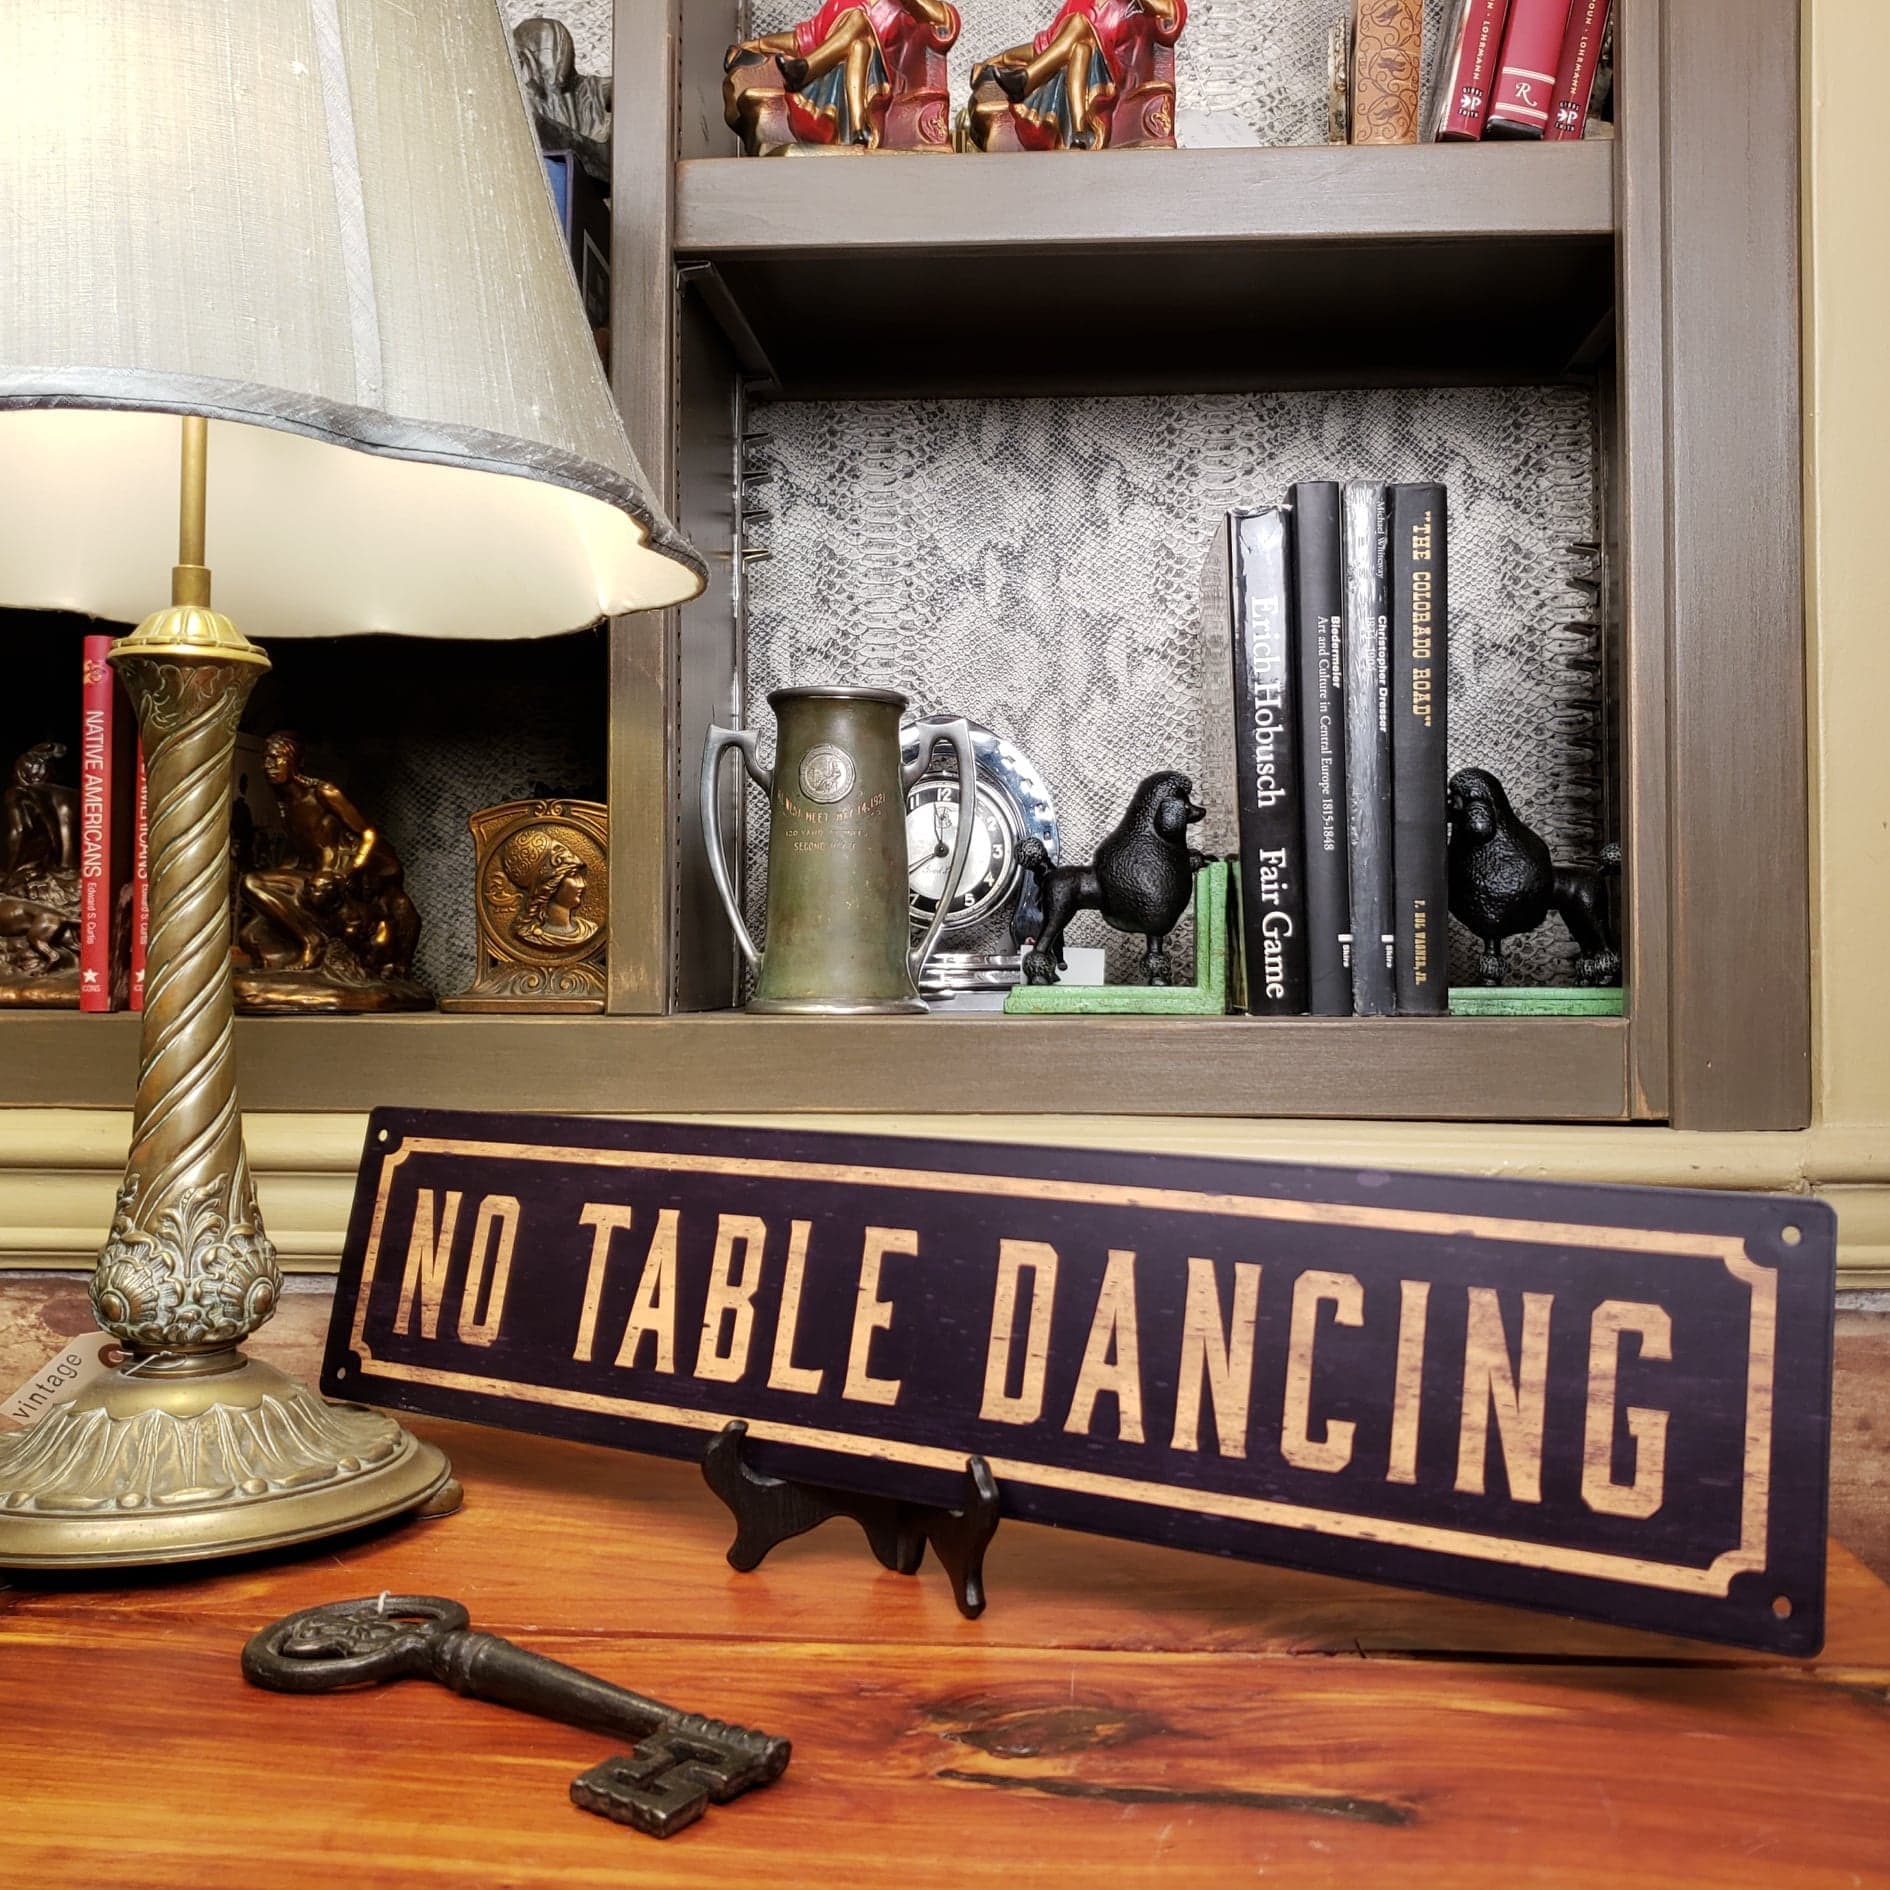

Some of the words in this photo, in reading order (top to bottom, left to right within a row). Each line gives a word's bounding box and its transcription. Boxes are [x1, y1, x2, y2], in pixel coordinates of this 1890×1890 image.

[1473, 21, 1490, 80] LOHRMANN
[1570, 36, 1589, 94] LOHRMANN
[1251, 596, 1281, 673] Erich
[1317, 616, 1329, 633] Art
[1412, 571, 1431, 658] COLORADO
[1318, 636, 1330, 656] and
[1331, 616, 1342, 688] Biedermeier
[1377, 615, 1387, 685] Christopher
[1319, 659, 1331, 699] Culture
[1319, 702, 1331, 712] in
[1320, 715, 1333, 754] Central
[1379, 687, 1388, 732] Dresser
[86, 710, 104, 770] NATIVE
[1254, 681, 1286, 808] Hobusch
[937, 788, 952, 802] 12
[1318, 755, 1333, 795] Europe
[83, 773, 104, 879] AMERICANS
[992, 844, 1003, 859] 3
[1321, 798, 1335, 851] 1815-1848
[87, 882, 97, 911] Edward
[964, 893, 975, 906] 5
[984, 871, 995, 887] 4
[1259, 848, 1288, 905] Fair
[1262, 911, 1293, 999] Game
[393, 1188, 520, 1348] NO
[573, 1203, 919, 1406] TABLE
[979, 1239, 1674, 1520] DANCING
[13, 1354, 82, 1419] vintage
